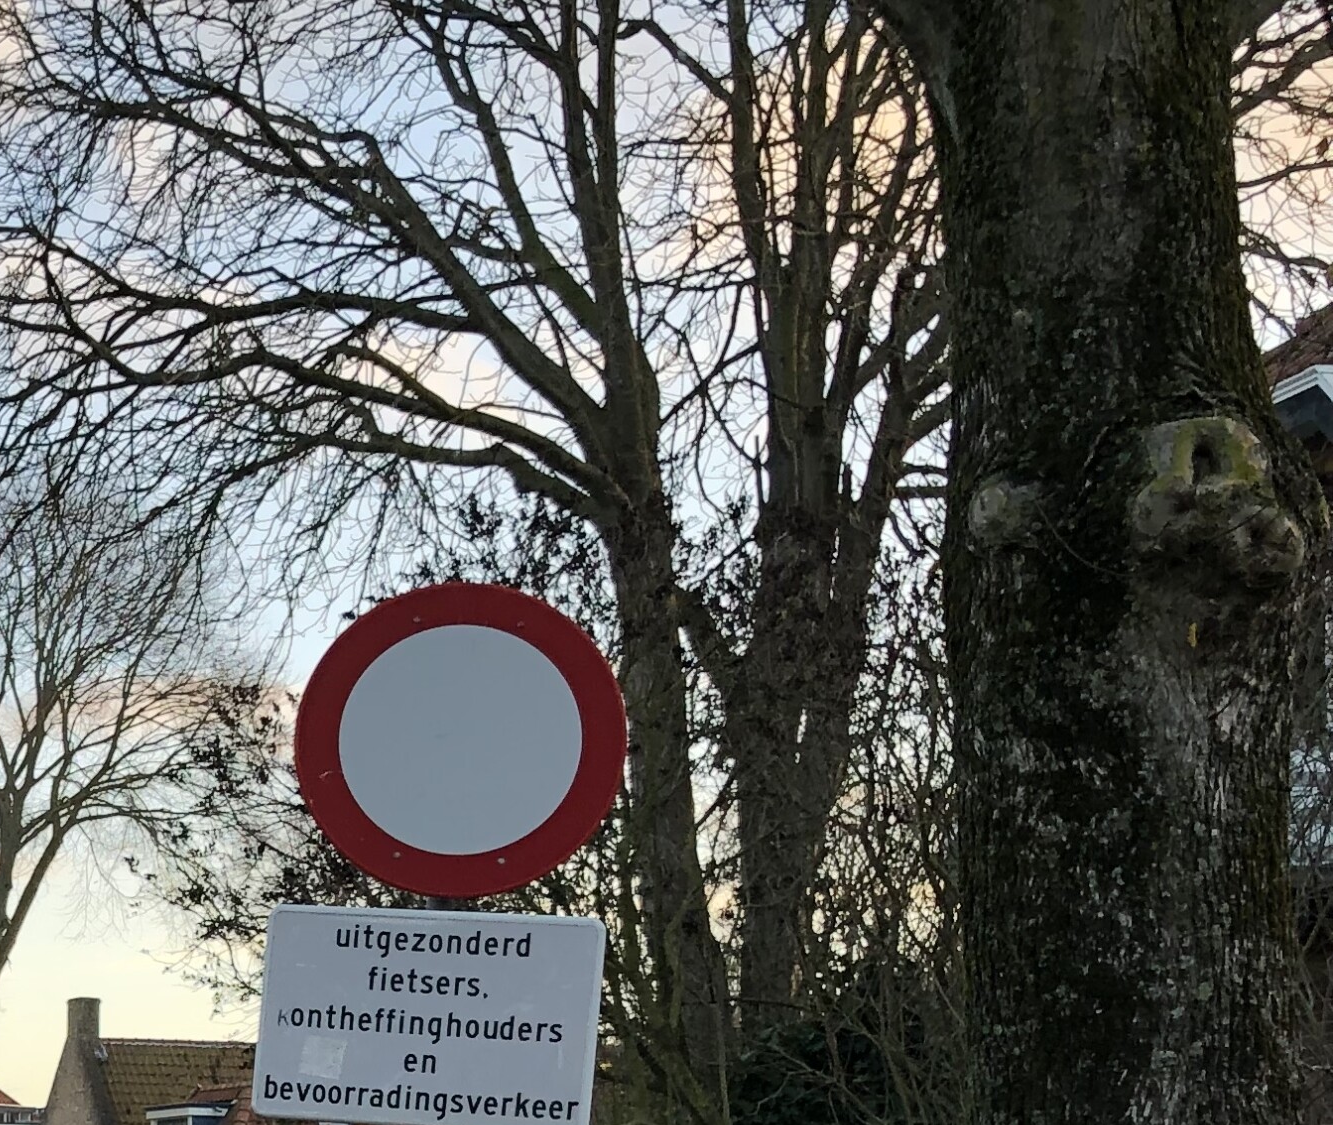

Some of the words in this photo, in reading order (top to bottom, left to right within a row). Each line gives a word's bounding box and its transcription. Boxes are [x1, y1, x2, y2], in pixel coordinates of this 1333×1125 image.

[336, 924, 532, 959] uitgezonderd
[403, 1051, 436, 1074] en
[264, 1075, 580, 1121] bevoorradingsverkeer
